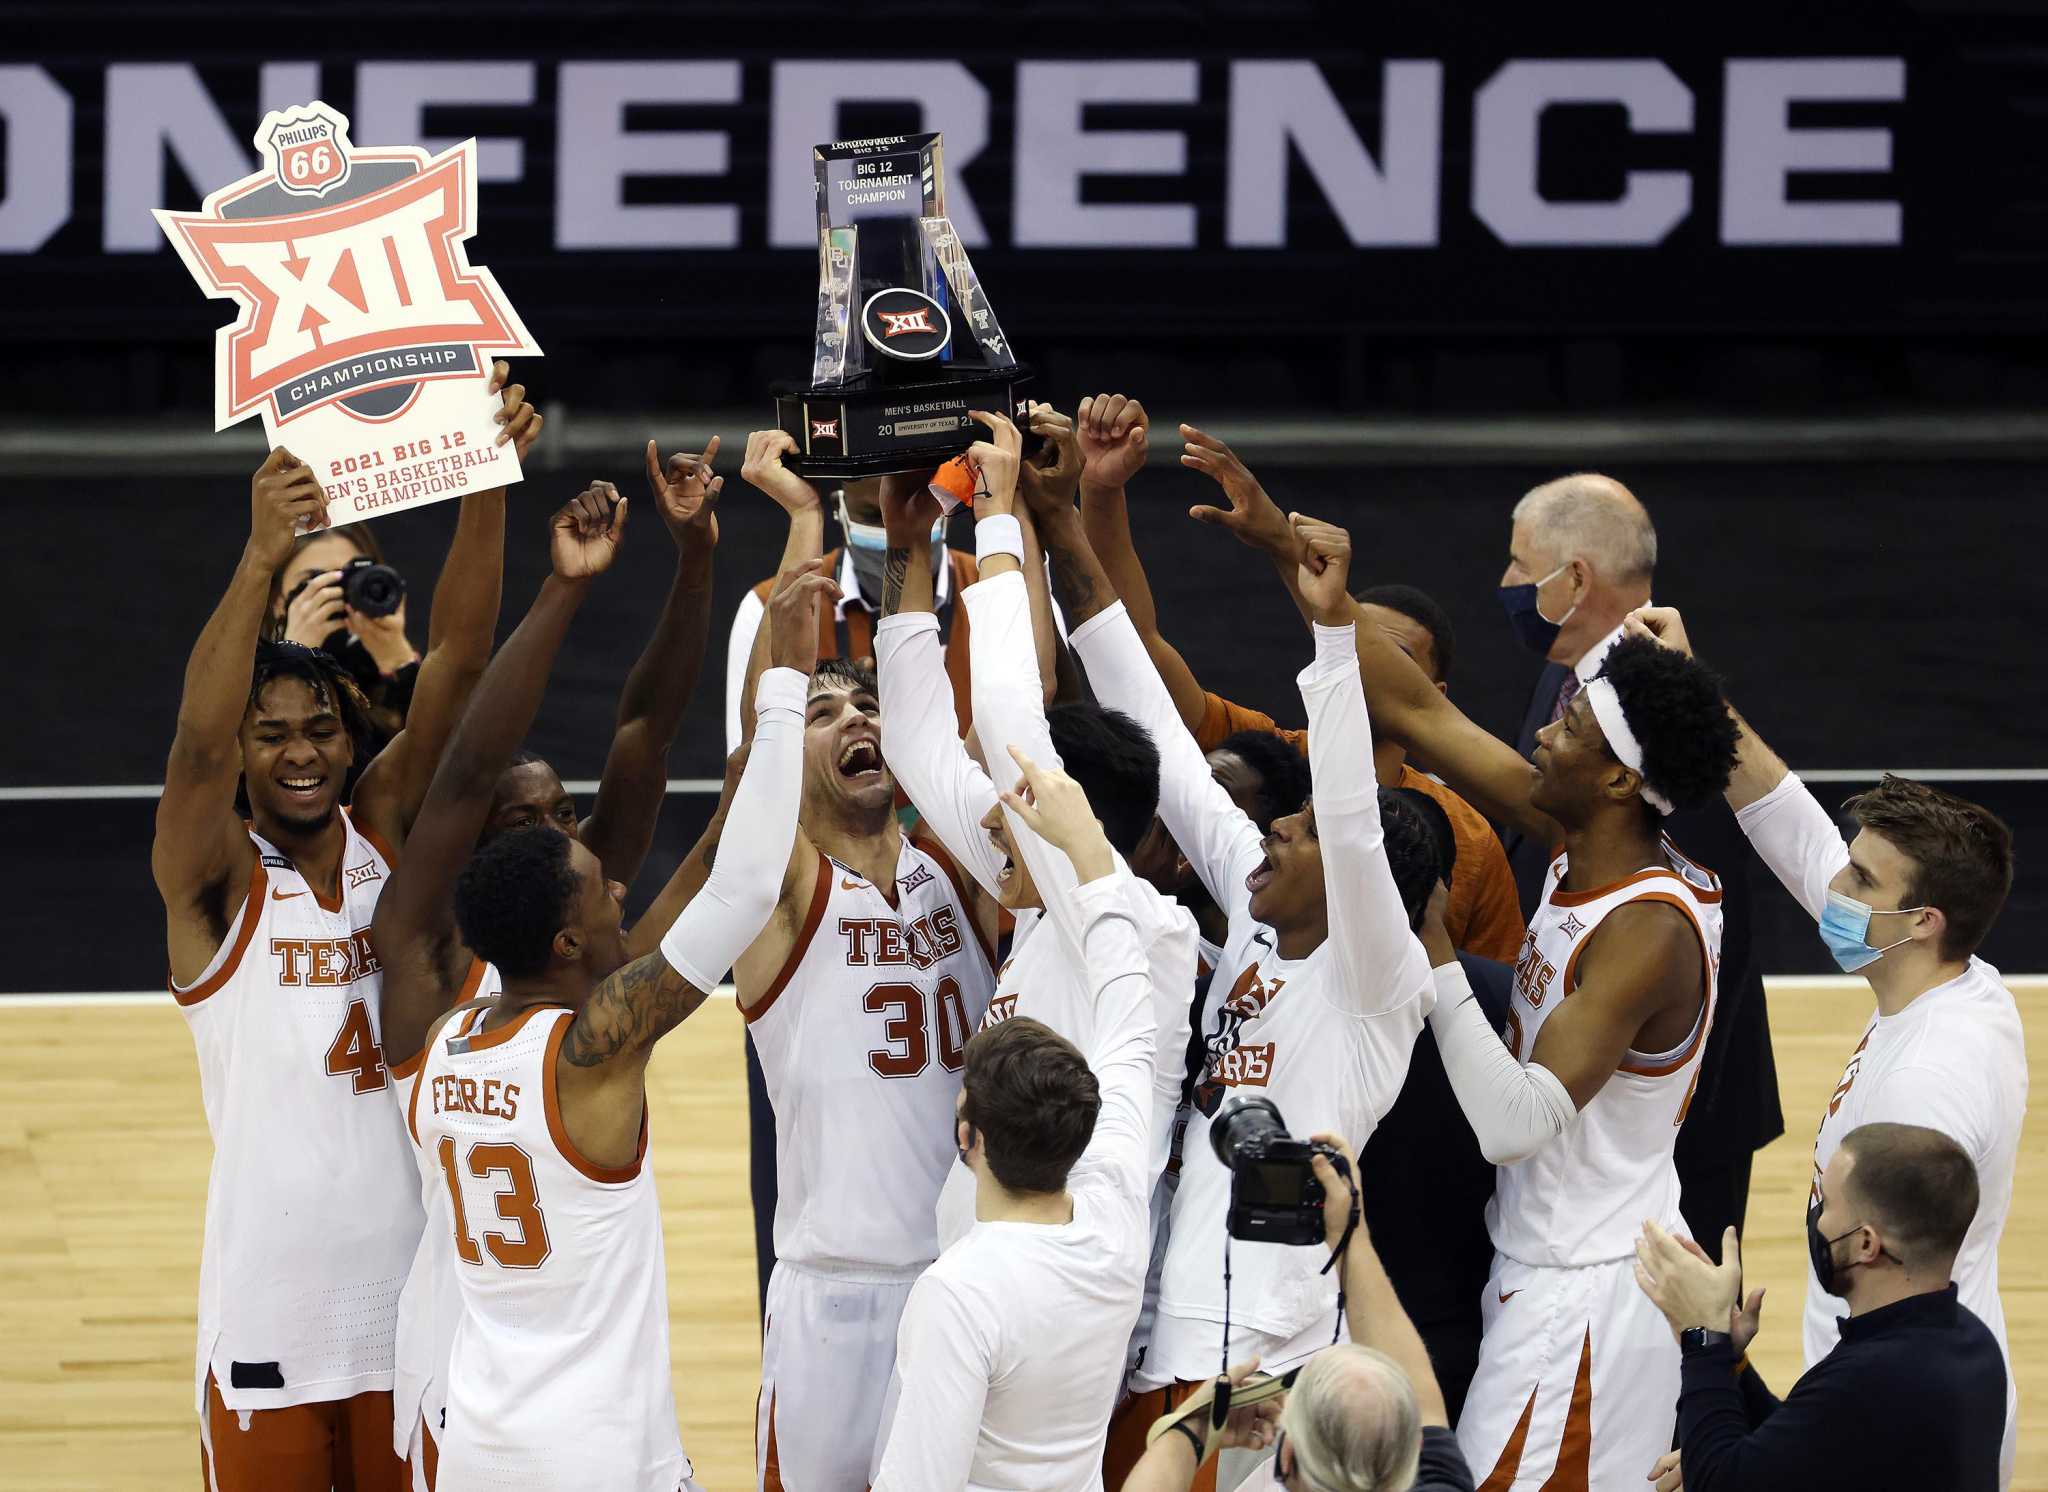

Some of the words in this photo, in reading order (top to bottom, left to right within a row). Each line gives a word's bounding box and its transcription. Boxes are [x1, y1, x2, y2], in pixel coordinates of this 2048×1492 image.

[277, 123, 328, 147] PHILLIPS
[290, 145, 332, 181] 66
[837, 173, 914, 192] TOURNAMENT
[857, 163, 876, 175] BIG
[879, 161, 893, 173] 12
[847, 189, 906, 205] CHAMPION
[211, 186, 485, 380] XII
[881, 310, 932, 336] XII
[290, 349, 458, 402] CHAMPIONSHIP
[813, 421, 838, 437] XII
[878, 424, 893, 437] 20
[898, 422, 929, 432] UNIVERSITY
[938, 419, 955, 428] TEXAS
[961, 415, 975, 427] 21
[884, 404, 911, 417] MEN'S
[913, 400, 967, 413] BASKETBALL
[322, 477, 369, 501] EN'S
[374, 446, 500, 490] BASKETBALL
[329, 450, 385, 477] 2021
[392, 439, 433, 462] BIG
[440, 431, 467, 450] 12
[353, 471, 469, 512] CHAMPIONS
[270, 924, 384, 987] TEXA
[324, 996, 389, 1096] 4
[862, 974, 974, 1080] 30
[431, 1074, 521, 1122] FERES
[435, 1134, 552, 1271] 13
